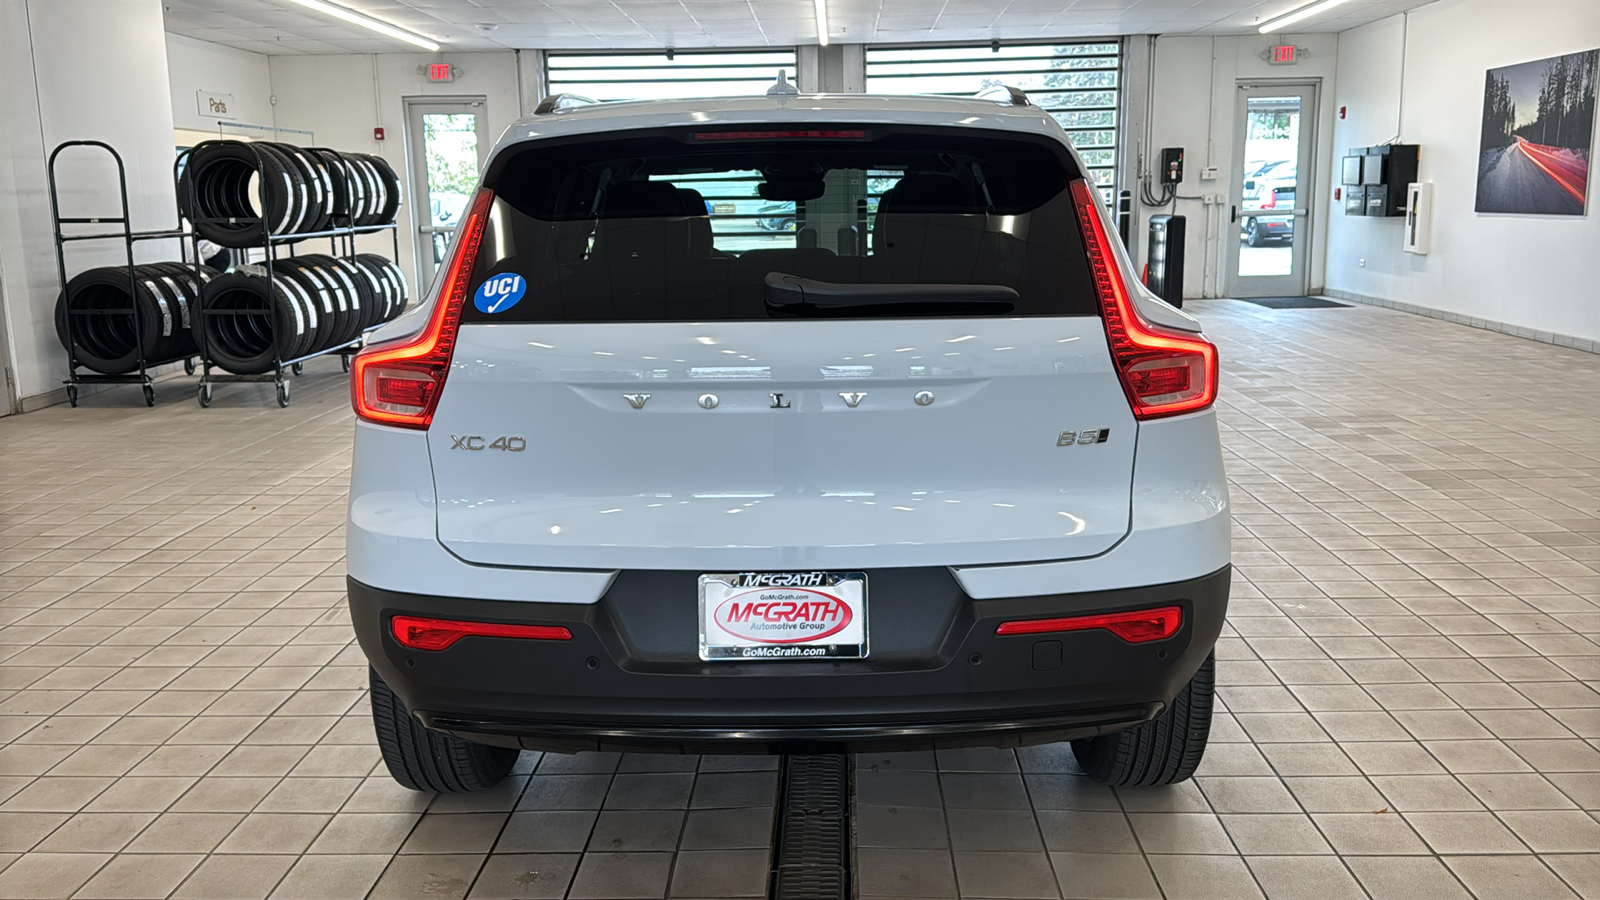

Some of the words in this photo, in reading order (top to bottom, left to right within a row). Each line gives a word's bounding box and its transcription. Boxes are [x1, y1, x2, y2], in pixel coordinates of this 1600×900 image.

[1274, 46, 1294, 62] EXIT
[430, 64, 449, 80] EXIT
[209, 97, 227, 113] Parts
[483, 275, 521, 298] UCI
[622, 390, 935, 409] VOLVO
[1056, 427, 1097, 447] B5
[750, 622, 797, 631] Automotive
[799, 622, 825, 631] Group
[742, 647, 826, 657] GoMcGrath.com
